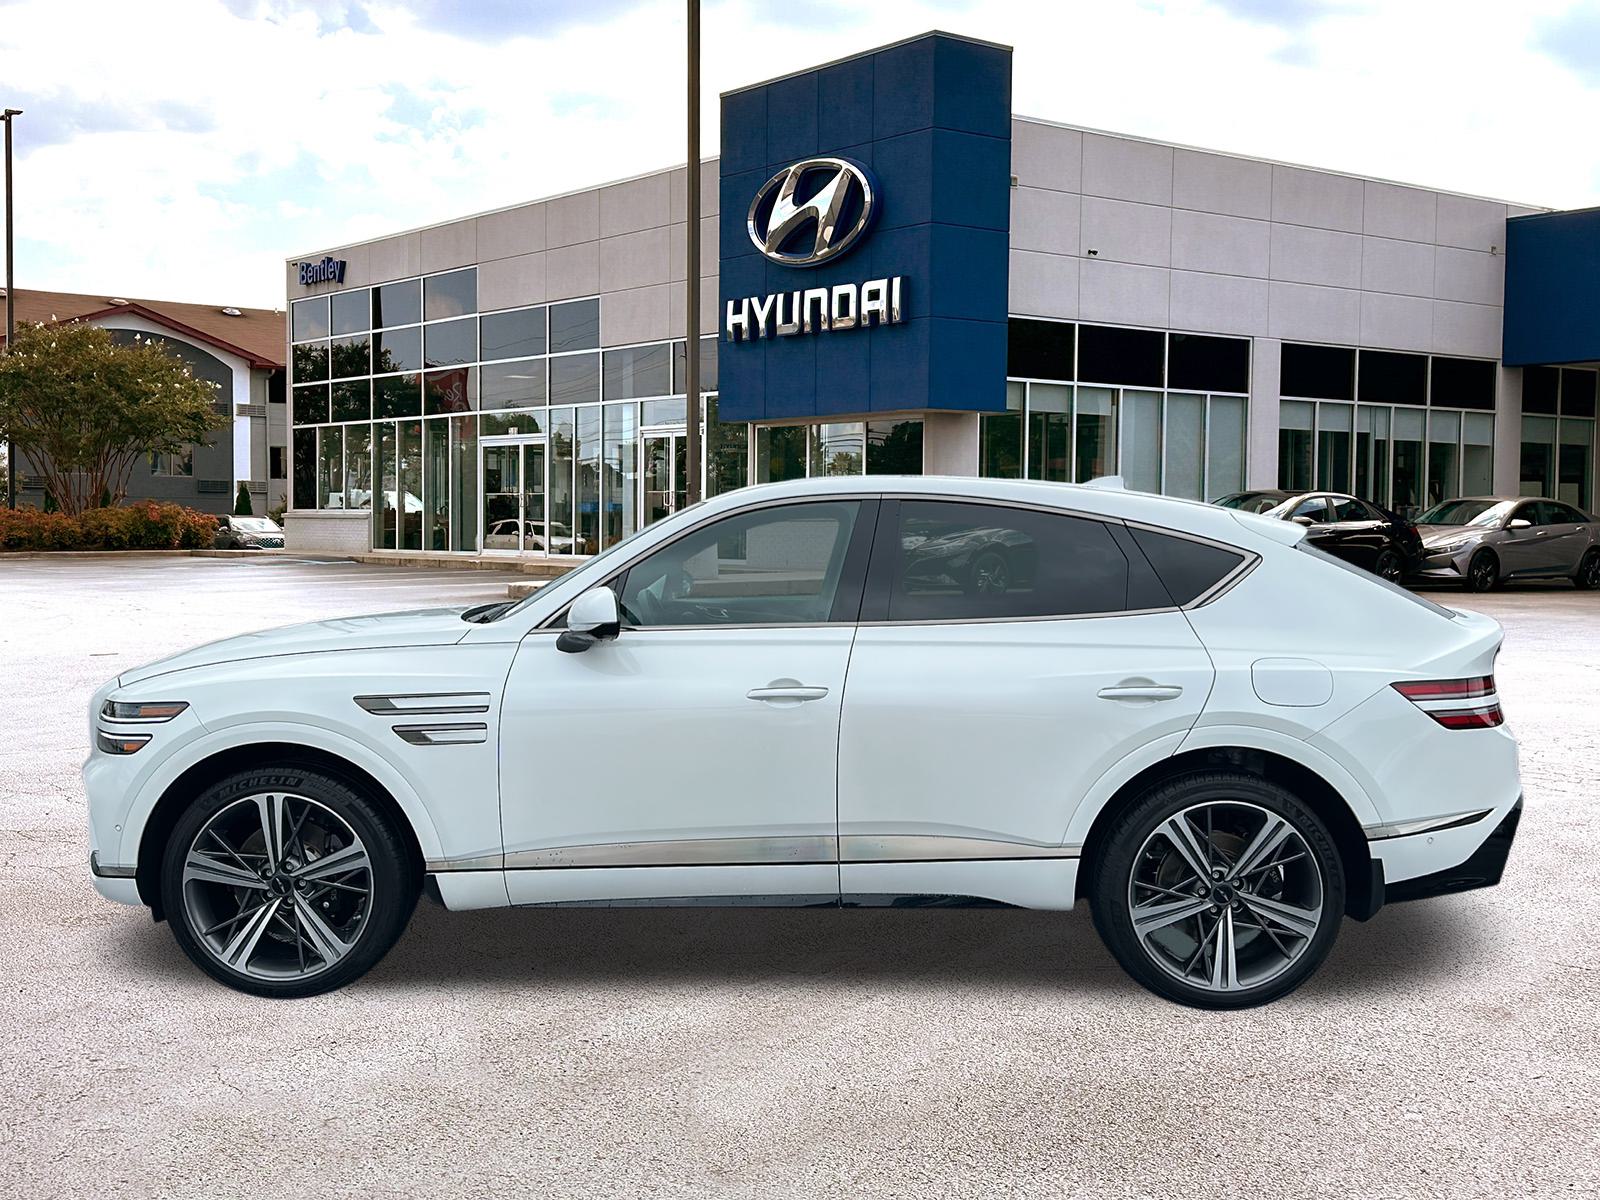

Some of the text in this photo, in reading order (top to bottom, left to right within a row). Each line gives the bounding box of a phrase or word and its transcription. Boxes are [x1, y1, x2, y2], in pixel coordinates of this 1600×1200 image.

[300, 257, 345, 285] Bentley
[726, 276, 904, 342] HYUNDAI
[219, 776, 299, 799] MICHELIN
